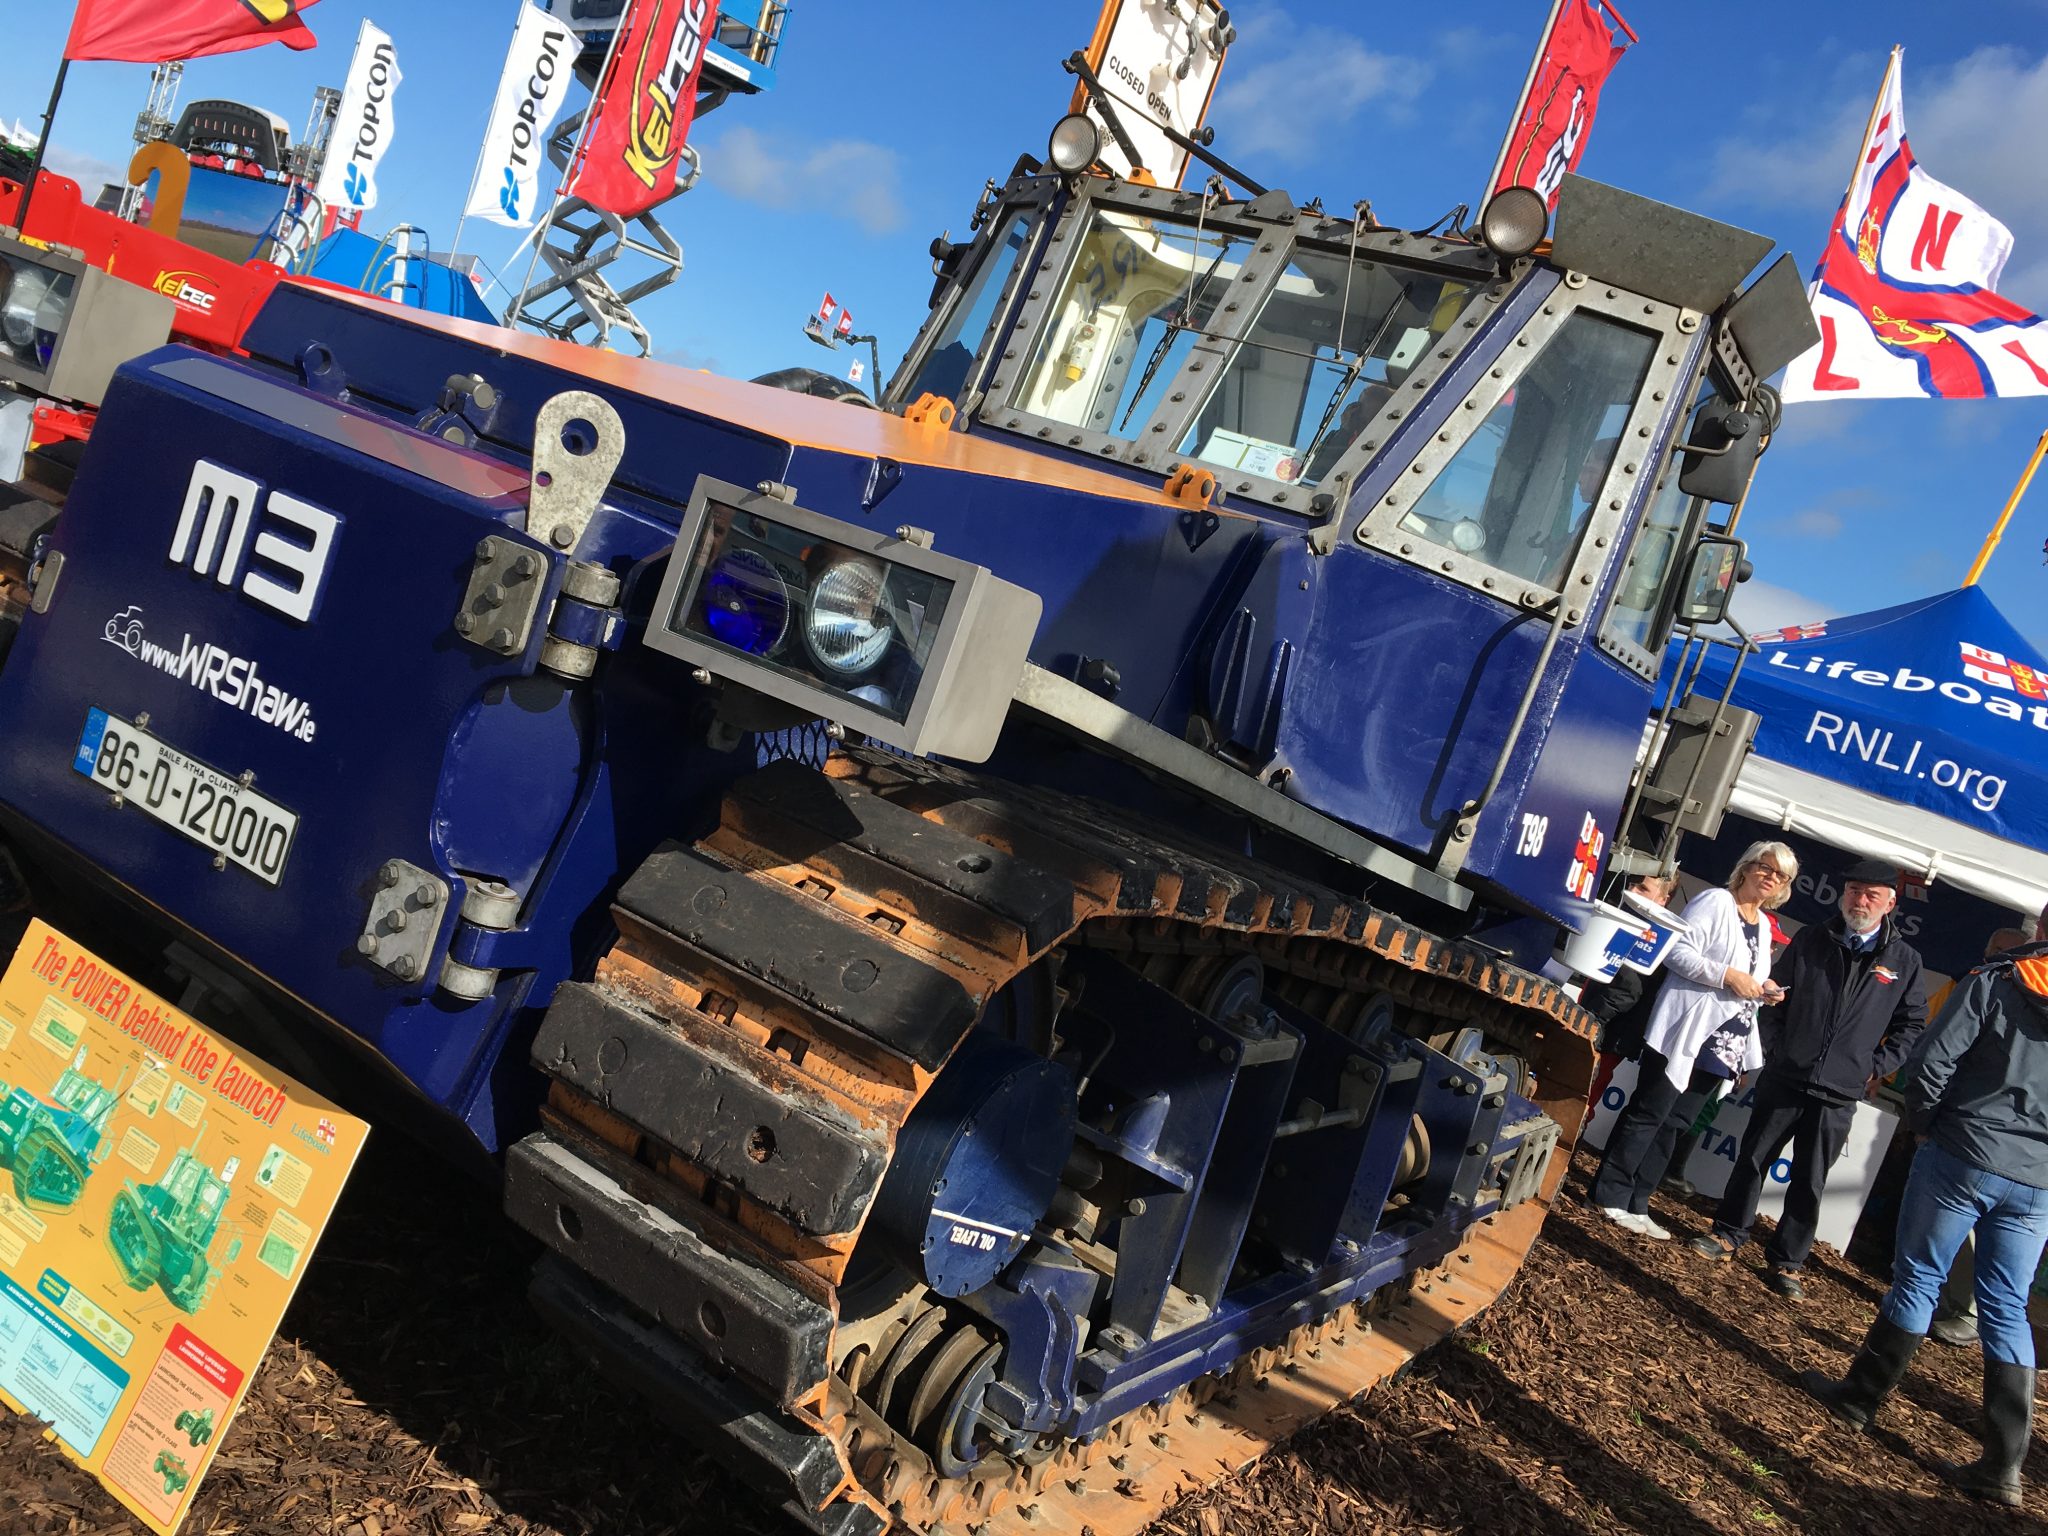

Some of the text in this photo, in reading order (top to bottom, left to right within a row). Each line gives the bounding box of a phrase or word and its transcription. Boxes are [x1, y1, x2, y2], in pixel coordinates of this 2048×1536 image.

[352, 43, 392, 161] TOPCON
[509, 31, 565, 166] TOPCON
[1109, 55, 1172, 121] CLOSED OPEN
[571, 254, 600, 276] DEPOT
[168, 459, 342, 623] M3
[140, 632, 316, 743] www.WRShaw.ie
[79, 743, 95, 764] IRL
[158, 746, 181, 766] BAILE
[208, 774, 240, 797] CLIATH
[1805, 710, 2007, 812] RNLI.org
[96, 730, 288, 876] 86-D-120010
[1516, 812, 1548, 858] T98
[31, 935, 67, 984] The
[61, 955, 131, 1024] POWER
[120, 993, 191, 1062] behind
[180, 1032, 218, 1083] the
[213, 1052, 287, 1126] launch
[950, 1225, 997, 1251] OIL LEVEL
[6, 1283, 35, 1309] LAUNCHING
[33, 1305, 46, 1317] AND
[44, 1314, 72, 1339] RECOVERY
